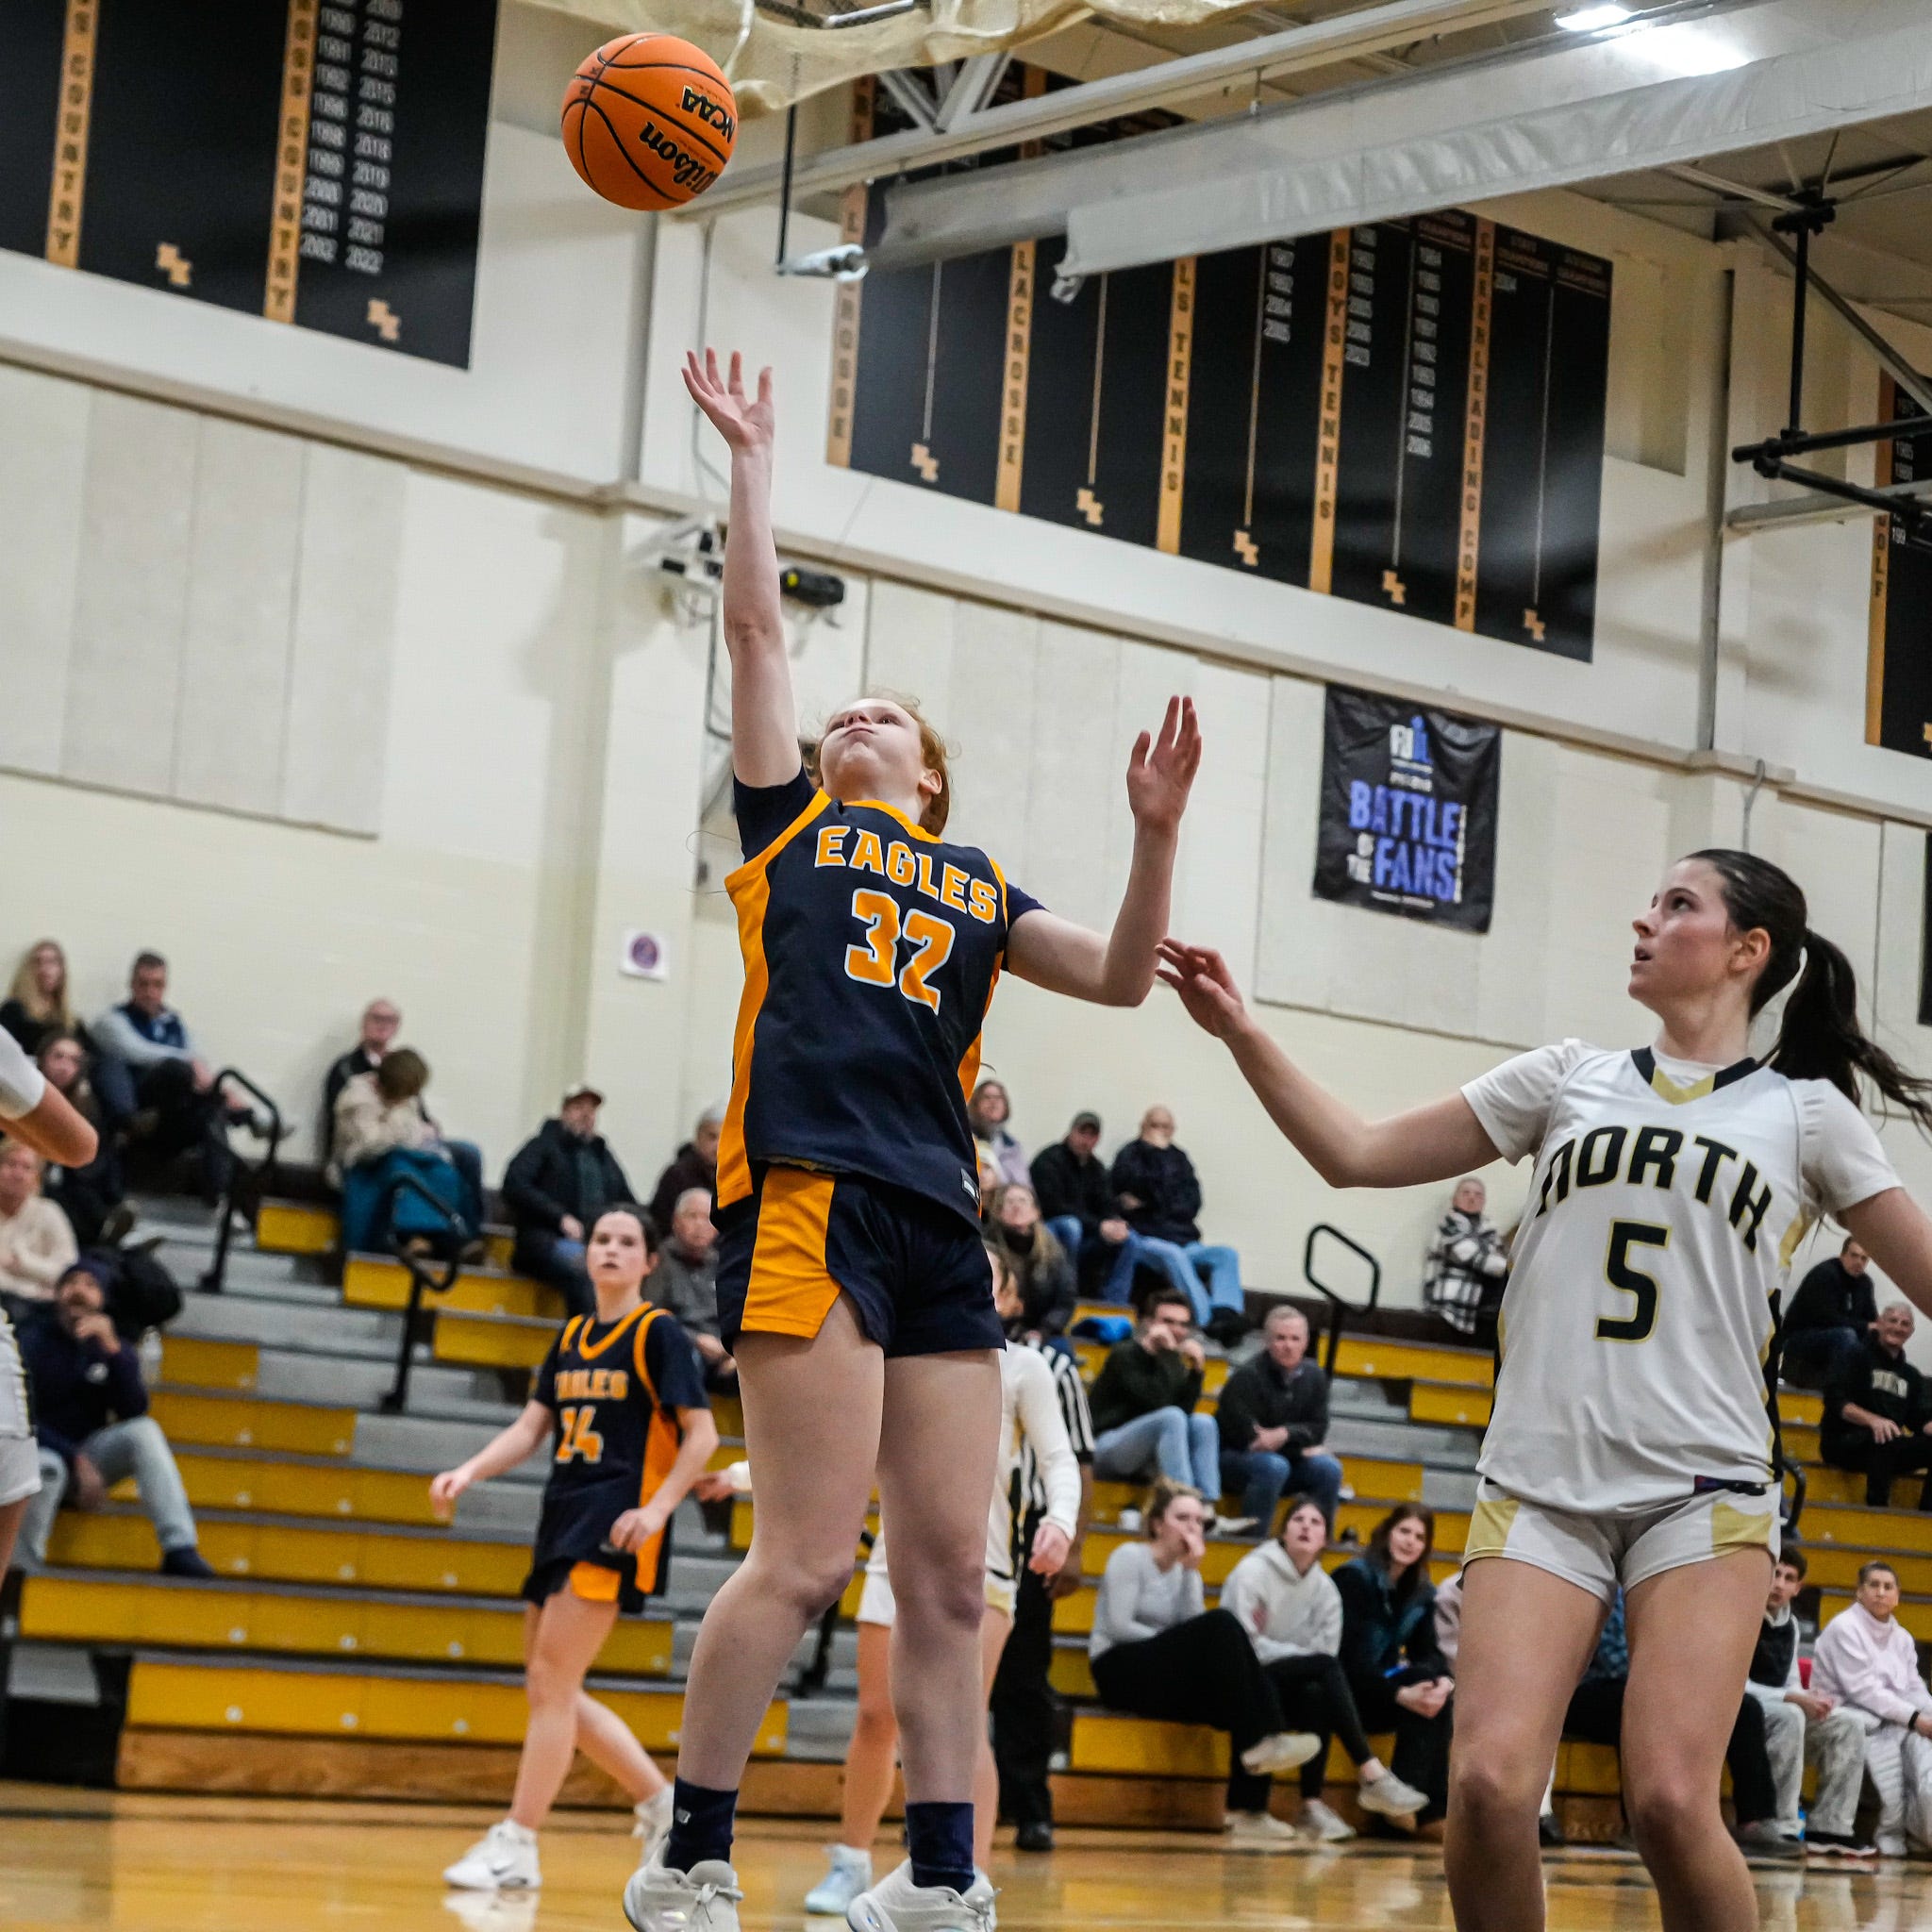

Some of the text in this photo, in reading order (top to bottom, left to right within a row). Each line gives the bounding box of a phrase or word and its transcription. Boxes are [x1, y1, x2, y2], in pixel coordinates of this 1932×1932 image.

[639, 121, 720, 194] Wilson
[680, 85, 736, 143] NCAA
[1165, 330, 1190, 492] TENNIS
[1319, 242, 1347, 521] BOYS TENNIS
[1349, 779, 1462, 851] BATTLE
[1374, 836, 1457, 903] FANS
[814, 824, 998, 924] EAGLES
[844, 887, 956, 1016] 32
[1534, 1124, 1773, 1255] NORTH
[1593, 1217, 1673, 1344] 5
